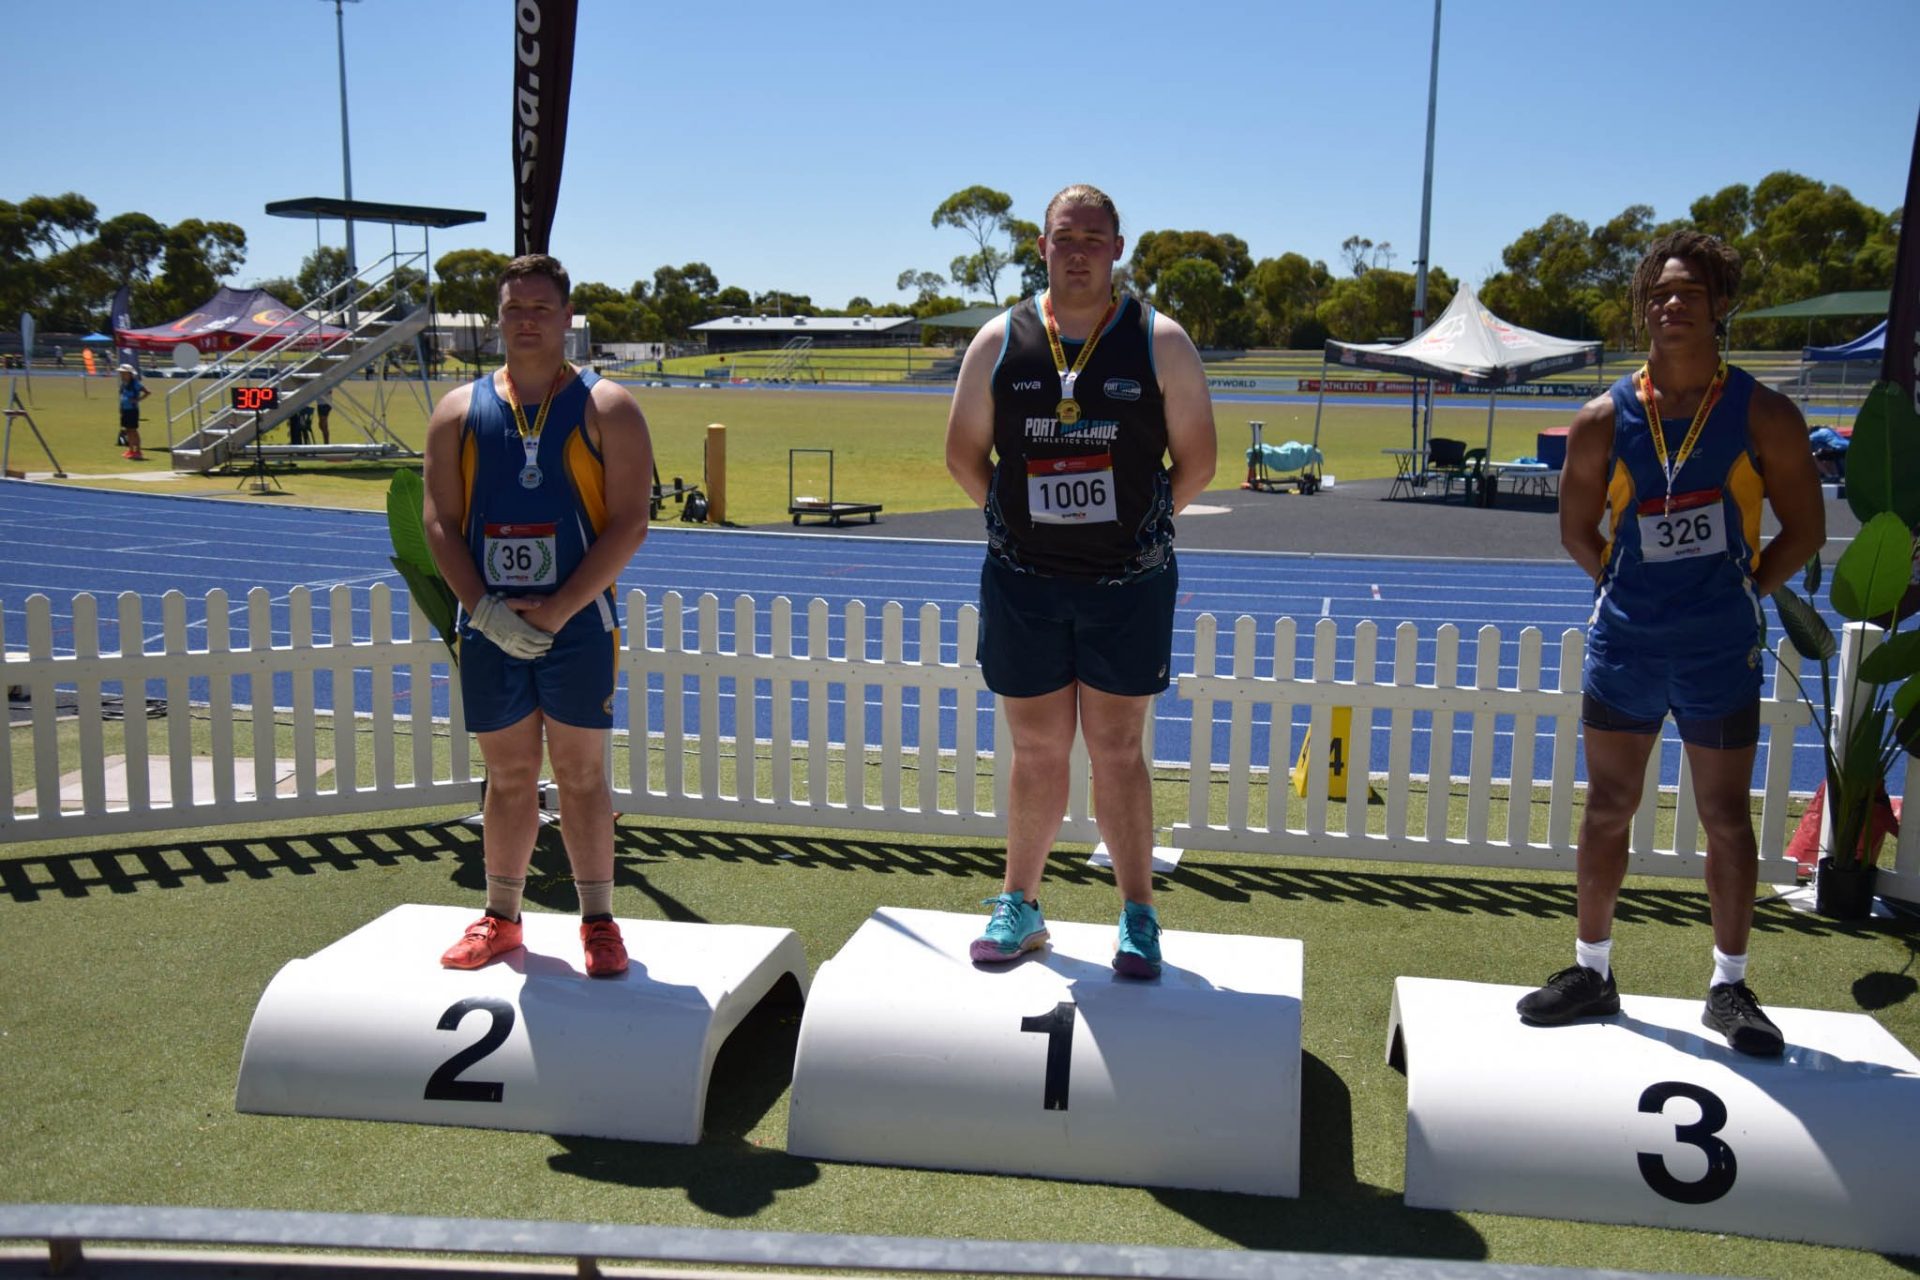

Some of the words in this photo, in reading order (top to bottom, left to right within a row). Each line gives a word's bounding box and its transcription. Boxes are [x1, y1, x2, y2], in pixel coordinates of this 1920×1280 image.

[1323, 382, 1368, 391] ATHLETICS
[1025, 418, 1058, 437] PORT
[1040, 478, 1106, 510] 1006
[1656, 514, 1712, 548] 326
[502, 545, 531, 571] 36
[1329, 737, 1345, 776] 4
[424, 997, 515, 1103] 2
[1021, 1001, 1077, 1111] 1
[1637, 1081, 1737, 1204] 3
